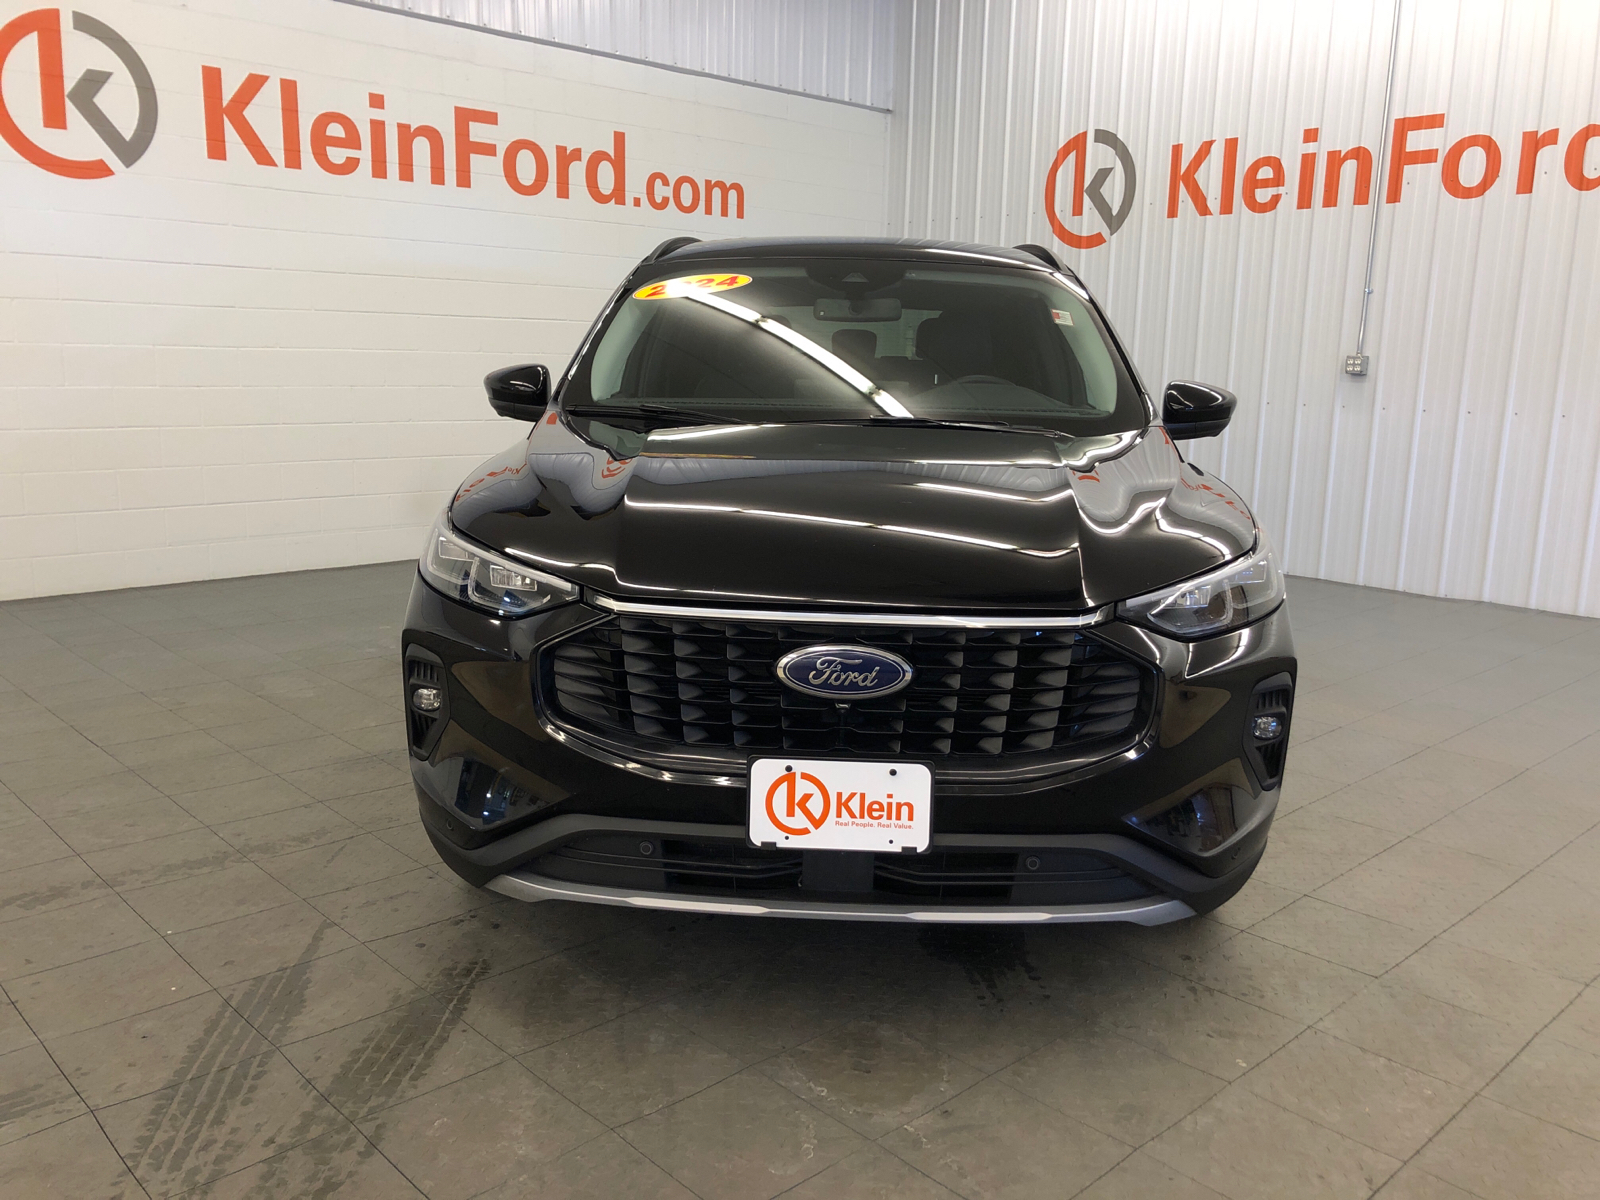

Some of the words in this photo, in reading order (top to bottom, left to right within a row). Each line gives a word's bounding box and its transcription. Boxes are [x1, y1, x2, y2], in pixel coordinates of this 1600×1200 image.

[201, 64, 746, 220] KleinFord.com
[645, 275, 739, 298] 224
[808, 656, 881, 687] Ford
[835, 791, 914, 822] Klein
